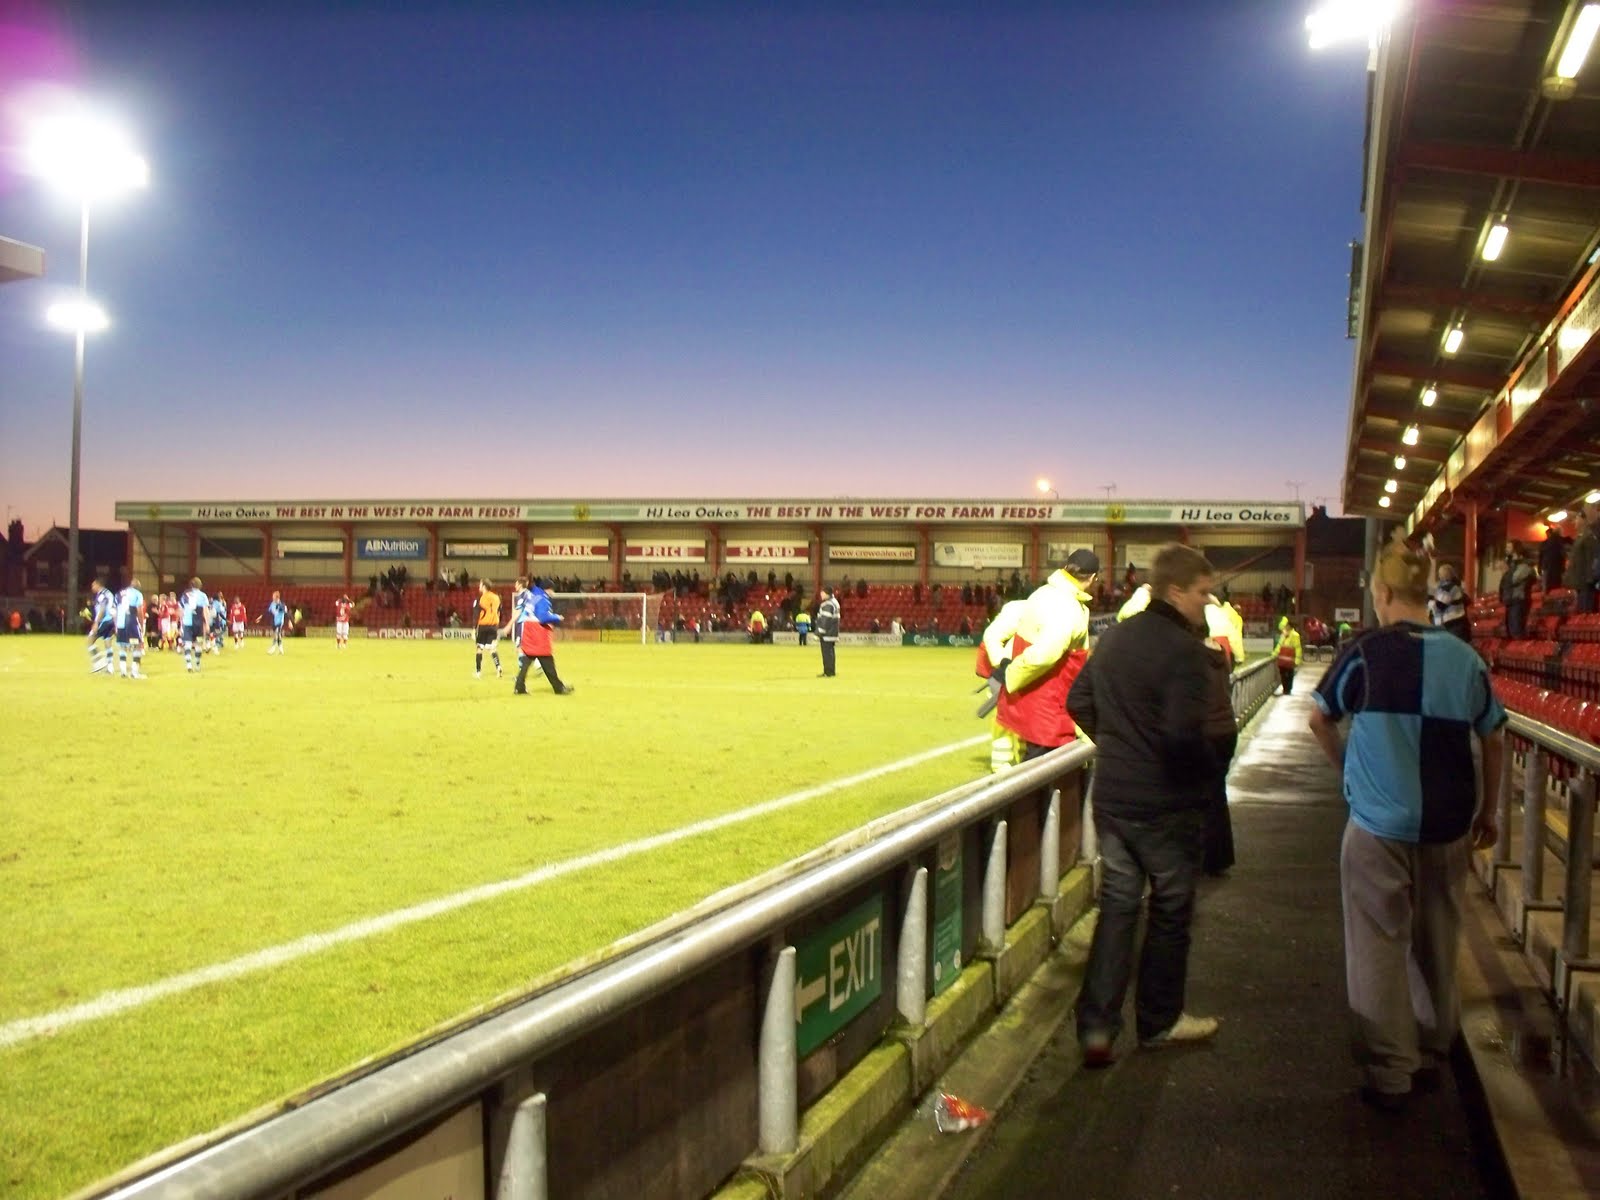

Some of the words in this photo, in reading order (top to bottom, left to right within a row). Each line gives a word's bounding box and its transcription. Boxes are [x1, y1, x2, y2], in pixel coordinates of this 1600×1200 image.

[198, 508, 211, 517] HJ
[214, 508, 232, 517] Lea
[236, 507, 270, 517] Oakes
[276, 507, 296, 517] THE
[300, 507, 326, 517] BEST
[331, 507, 343, 517] IN
[348, 507, 368, 517] THE
[374, 507, 405, 517] WEST
[410, 507, 433, 517] FOR
[438, 507, 473, 517] FARM
[479, 507, 521, 517] FEEDS!
[647, 508, 663, 518] HJ
[667, 508, 690, 518] Lea
[696, 507, 739, 517] Oakes
[746, 507, 772, 517] THE
[777, 507, 811, 517] BEST
[816, 507, 832, 517] IN
[839, 507, 864, 517] THE
[870, 507, 910, 517] WEST
[916, 507, 946, 517] FOR
[952, 507, 995, 517] FARM
[1001, 507, 1053, 518] FEEDS!
[1181, 509, 1200, 520] HJ
[1206, 509, 1232, 520] Lea
[1239, 509, 1290, 520] Oakes
[365, 540, 419, 552] ABNutrition
[548, 545, 592, 555] MARK
[642, 547, 688, 557] PRICE
[740, 547, 795, 557] STAND
[379, 628, 430, 639] npower
[829, 918, 879, 1012] EXIT
